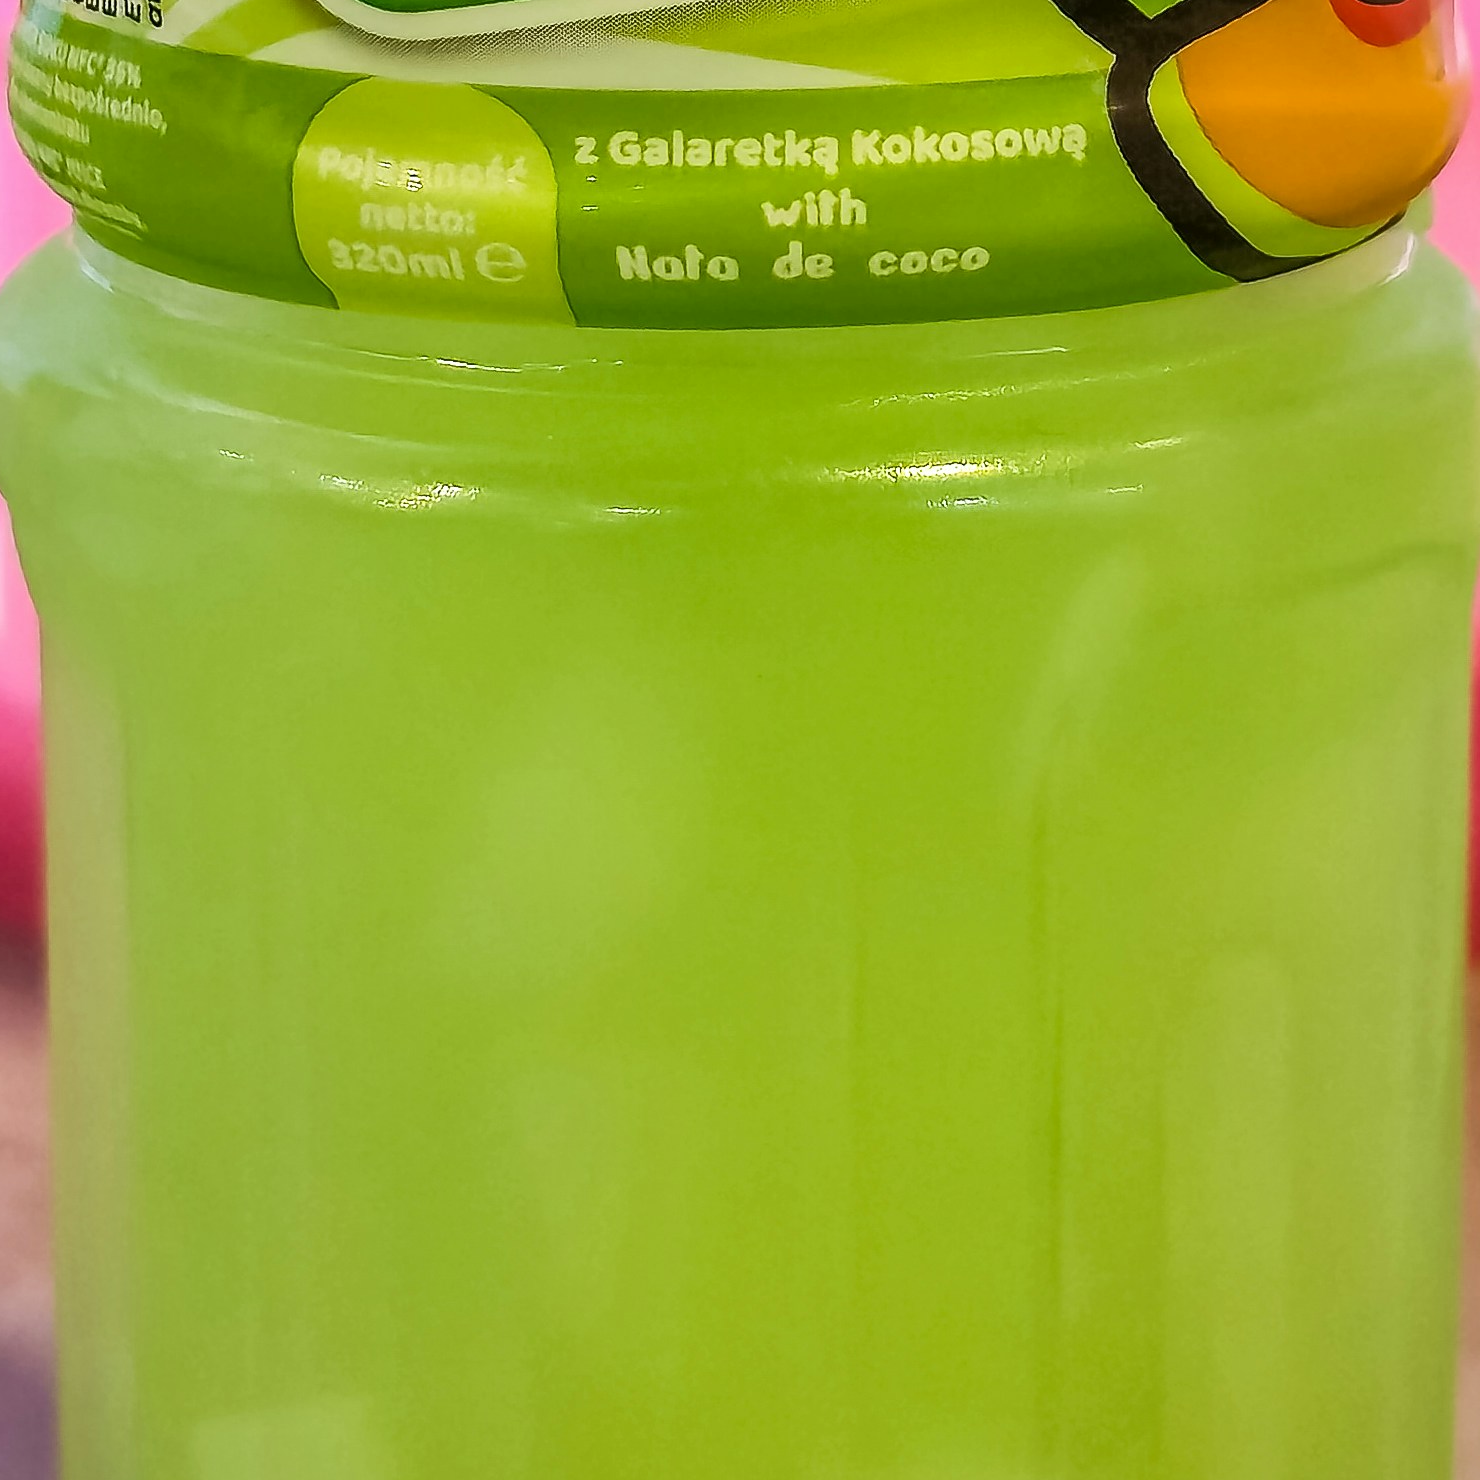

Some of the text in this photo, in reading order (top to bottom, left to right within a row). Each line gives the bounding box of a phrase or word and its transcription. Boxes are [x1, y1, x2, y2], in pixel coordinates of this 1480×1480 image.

[573, 123, 1087, 177] z Galaretką Kokosową
[760, 188, 868, 227] with
[327, 237, 466, 281] 320ml
[771, 240, 835, 279] de
[867, 245, 992, 277] coco
